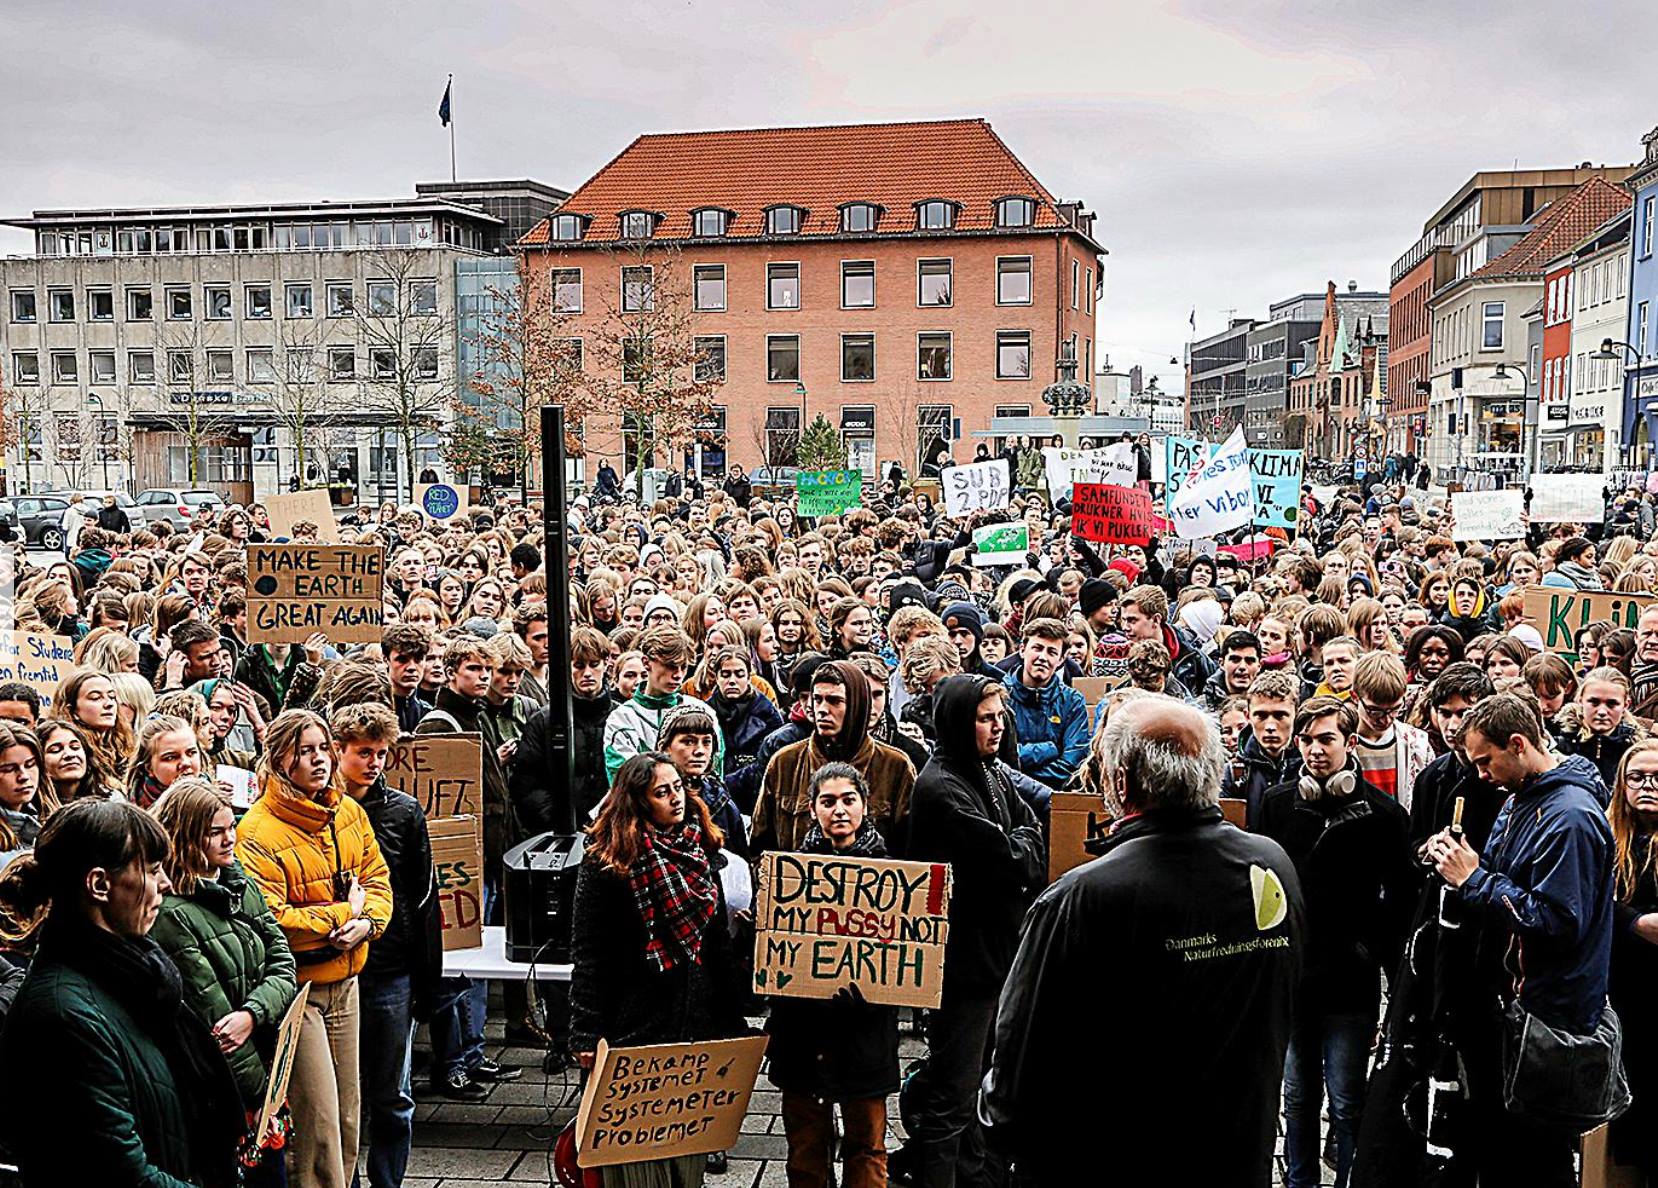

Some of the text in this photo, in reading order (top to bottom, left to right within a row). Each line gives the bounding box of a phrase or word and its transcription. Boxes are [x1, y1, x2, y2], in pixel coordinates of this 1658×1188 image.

[257, 550, 380, 575] MAKE THE
[295, 574, 362, 596] EARTH
[257, 603, 327, 630] GREAT
[773, 906, 812, 934] MY
[900, 916, 947, 945] NOT
[767, 937, 923, 987] MY EARTH
